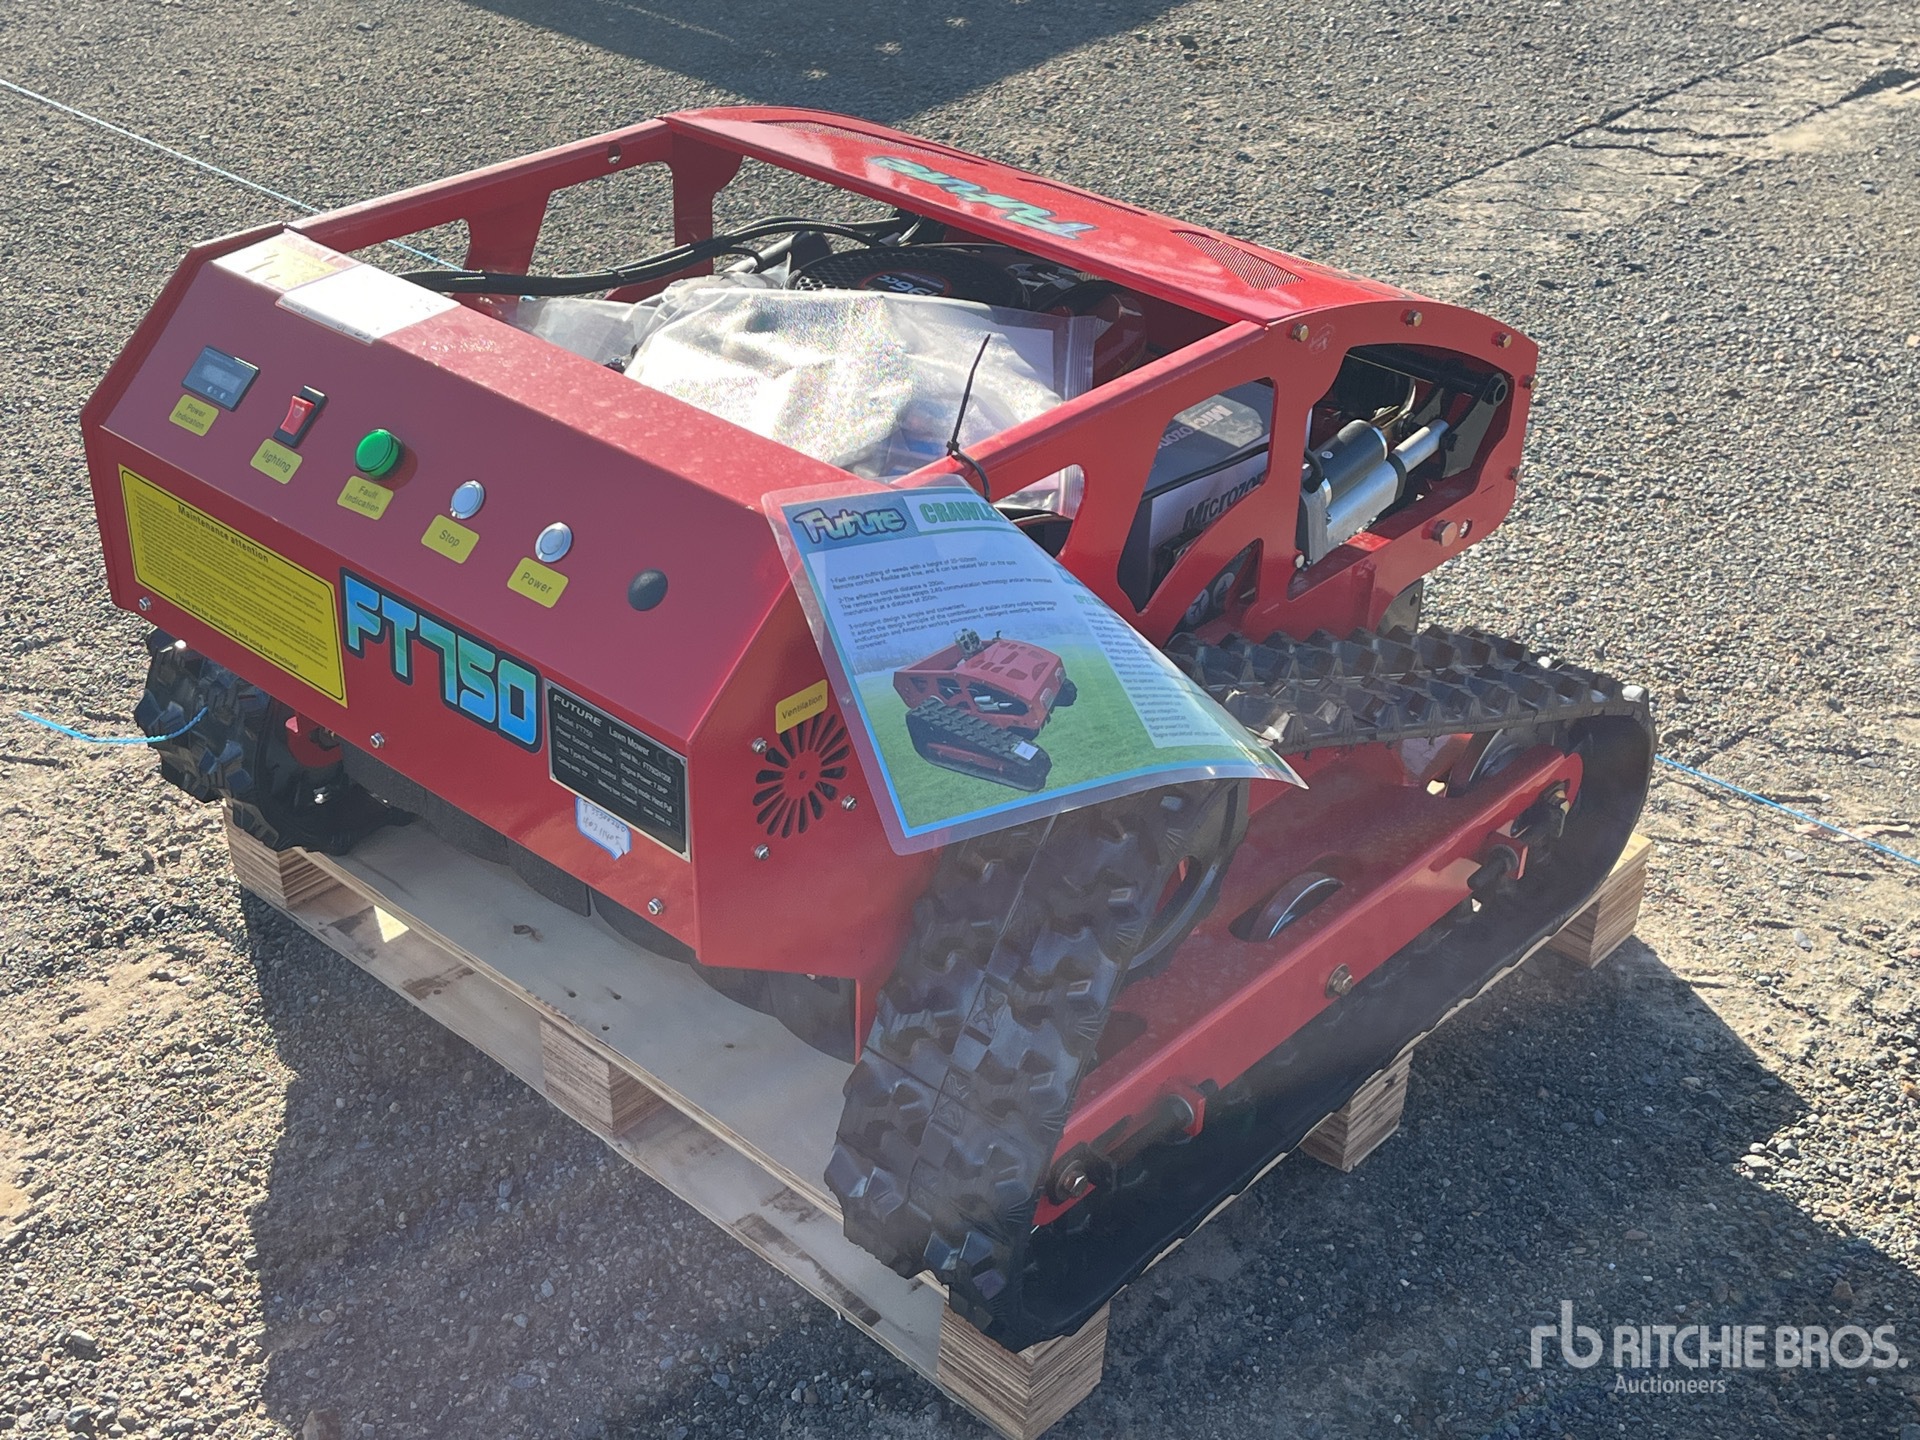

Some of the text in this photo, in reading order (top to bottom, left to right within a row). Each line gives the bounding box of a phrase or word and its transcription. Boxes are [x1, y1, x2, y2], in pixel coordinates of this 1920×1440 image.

[175, 411, 205, 430] Indication
[186, 403, 206, 418] Power
[1157, 404, 1233, 450] Microzon
[262, 449, 291, 473] lighting
[345, 493, 380, 513] Indication
[358, 485, 379, 500] Fault
[177, 504, 269, 563] Maintenance attention
[792, 507, 907, 544] Future
[439, 529, 461, 548] Stop
[521, 571, 553, 594] Power
[342, 572, 540, 748] FT750
[781, 694, 823, 719] Ventilation
[553, 694, 603, 728] FUTURE
[608, 726, 627, 744] Lawn
[627, 736, 650, 757] Mower
